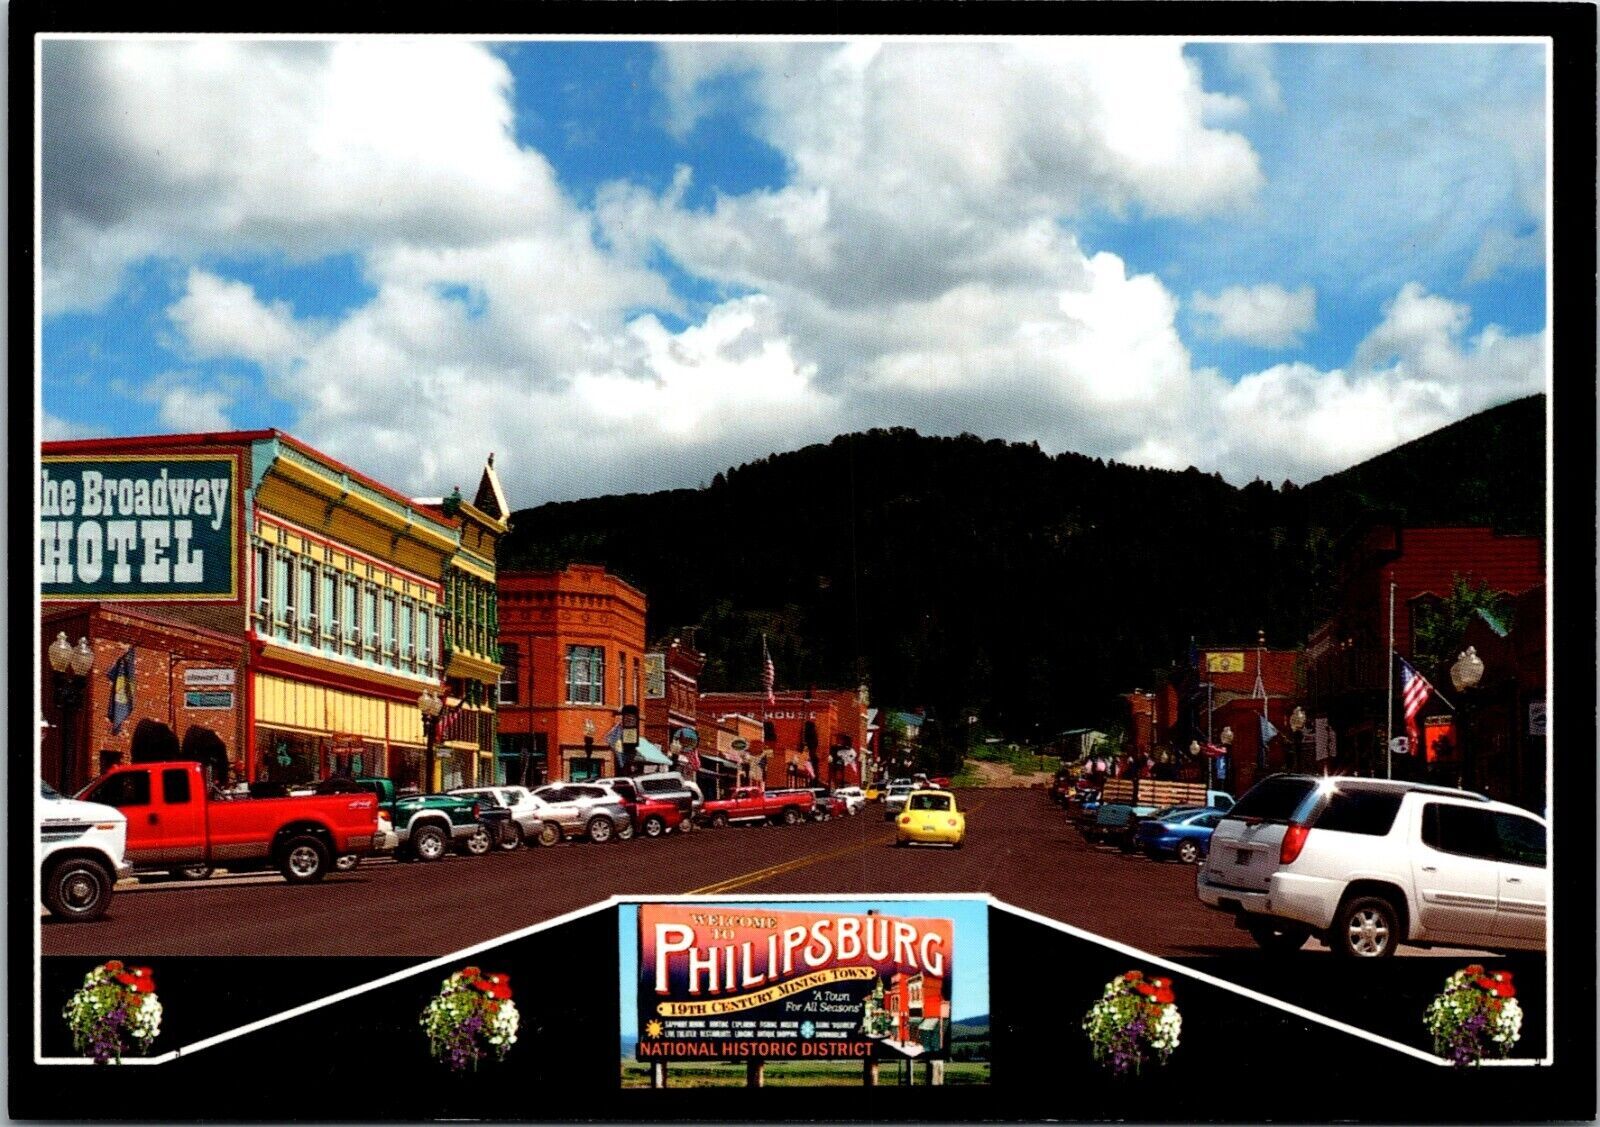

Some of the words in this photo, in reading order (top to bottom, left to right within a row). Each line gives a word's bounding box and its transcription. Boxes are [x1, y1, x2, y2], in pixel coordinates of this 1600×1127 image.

[41, 469, 76, 516] he
[82, 468, 229, 531] Broadway
[41, 520, 203, 583] HOTEL
[689, 913, 777, 928] WELCOME
[711, 928, 735, 940] TO
[654, 916, 945, 994] PHILIPSBURG
[670, 1003, 707, 1015] 19TH
[711, 990, 773, 1013] CENTURY
[777, 973, 827, 996] MINING
[831, 968, 869, 980] TOWN
[825, 991, 850, 1002] Town
[785, 1001, 802, 1012] For
[803, 1001, 818, 1012] All
[640, 1042, 718, 1056] NATIONAL
[722, 1042, 797, 1056] HISTORIC
[801, 1042, 873, 1056] DISTRICT
